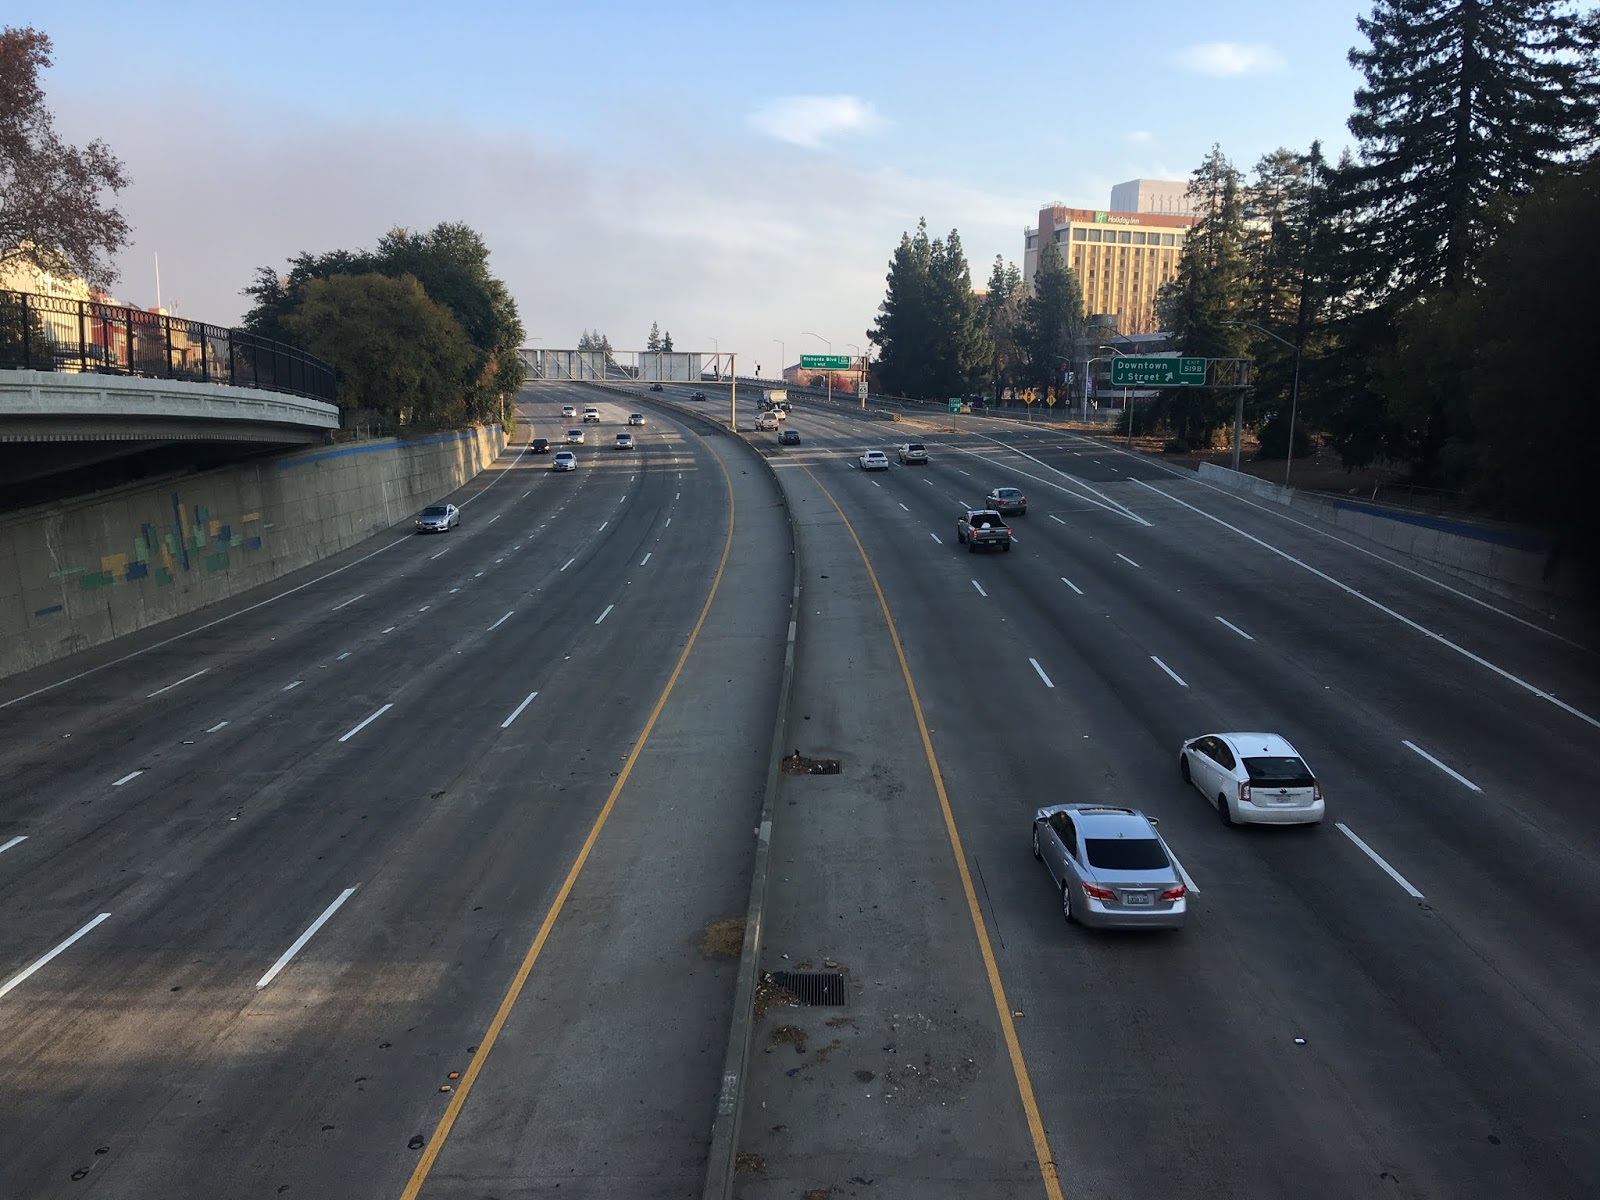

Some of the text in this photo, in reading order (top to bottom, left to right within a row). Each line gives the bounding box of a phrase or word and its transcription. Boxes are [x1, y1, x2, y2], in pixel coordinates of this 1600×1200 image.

[1107, 215, 1131, 225] Holiday
[1117, 361, 1168, 369] Downtown
[1127, 373, 1160, 381] Street
